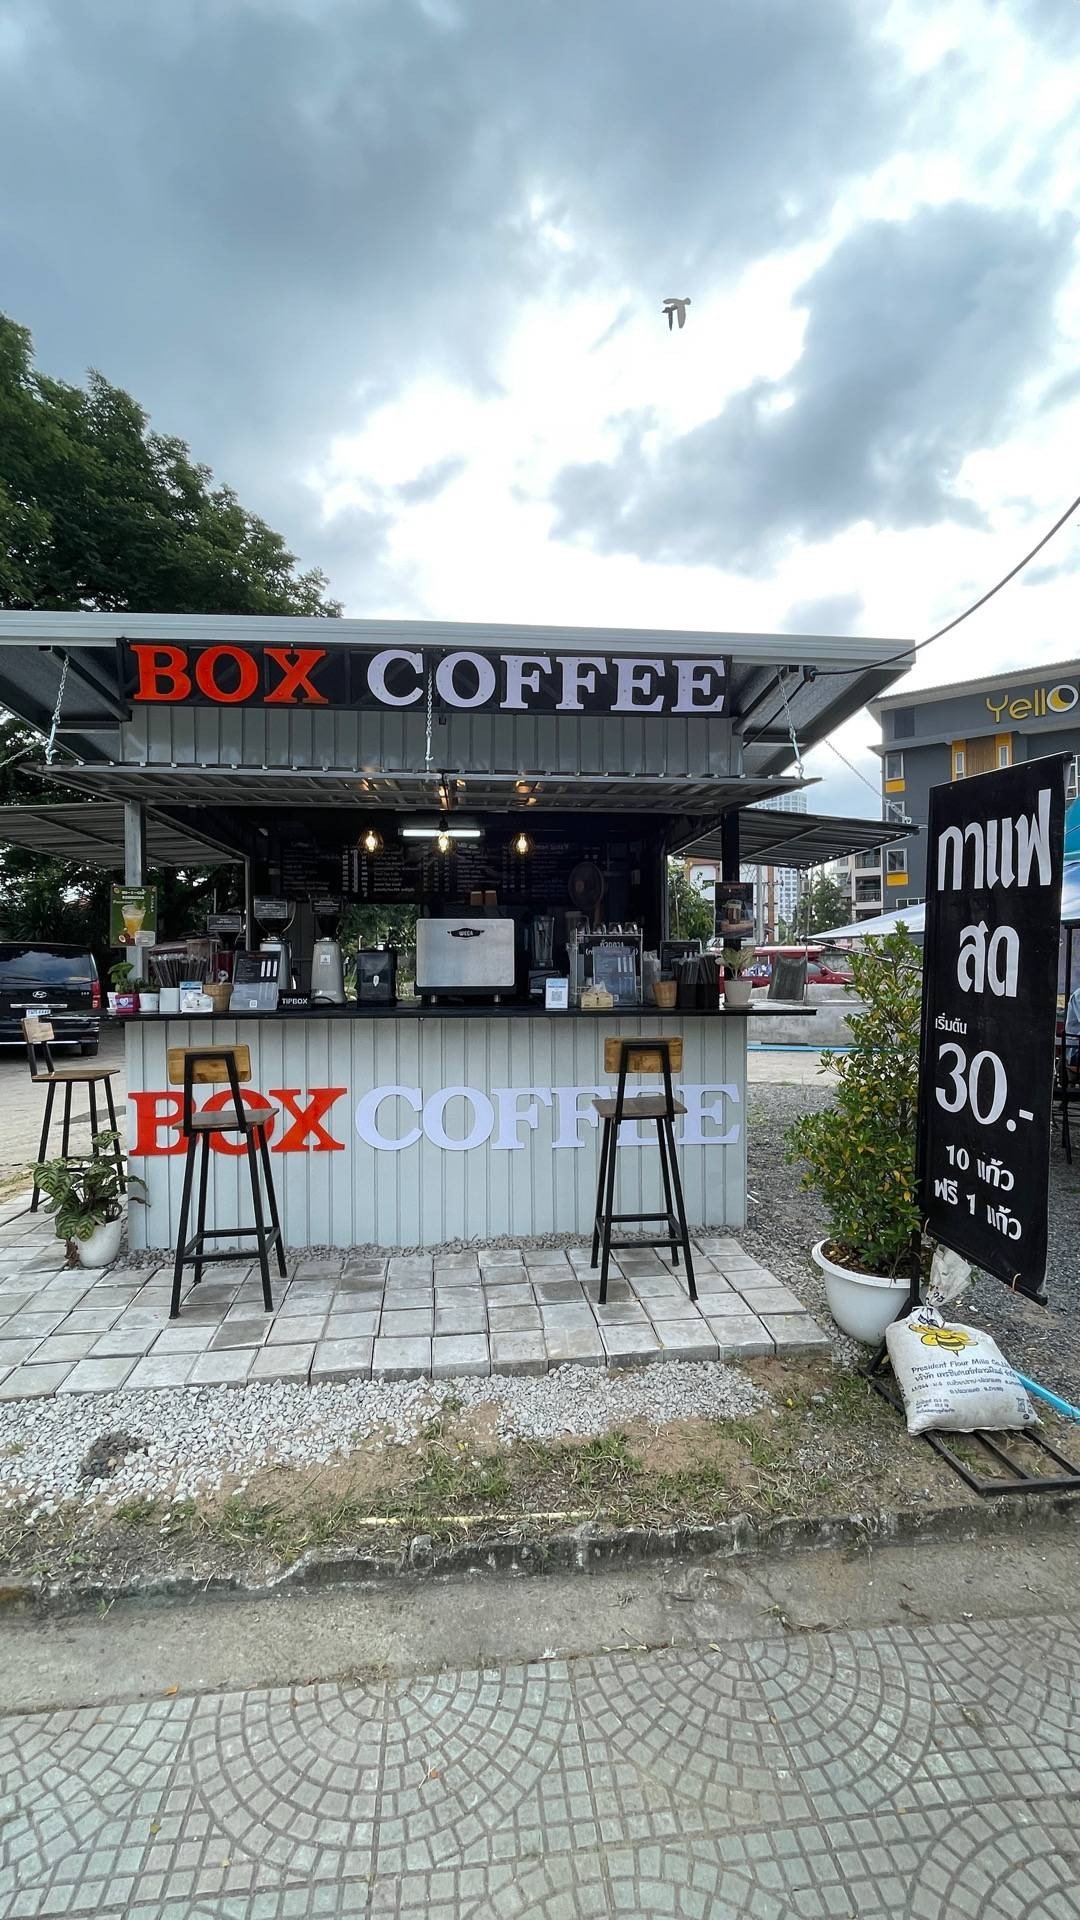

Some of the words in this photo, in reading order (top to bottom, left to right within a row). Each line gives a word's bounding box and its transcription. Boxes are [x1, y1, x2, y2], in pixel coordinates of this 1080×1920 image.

[130, 644, 329, 704] BOX
[367, 648, 726, 713] COFFEE
[937, 788, 1052, 891] กาแฟ
[957, 920, 1020, 998] สด
[128, 1087, 348, 1156] BOX
[945, 1144, 970, 1171] 10
[976, 1157, 1015, 1191] แก้ว
[934, 1177, 959, 1205] ฟรี
[966, 1193, 976, 1216] 1
[986, 1204, 1022, 1241] แก้ว
[911, 1361, 947, 1374] President
[949, 1360, 969, 1368] Flour
